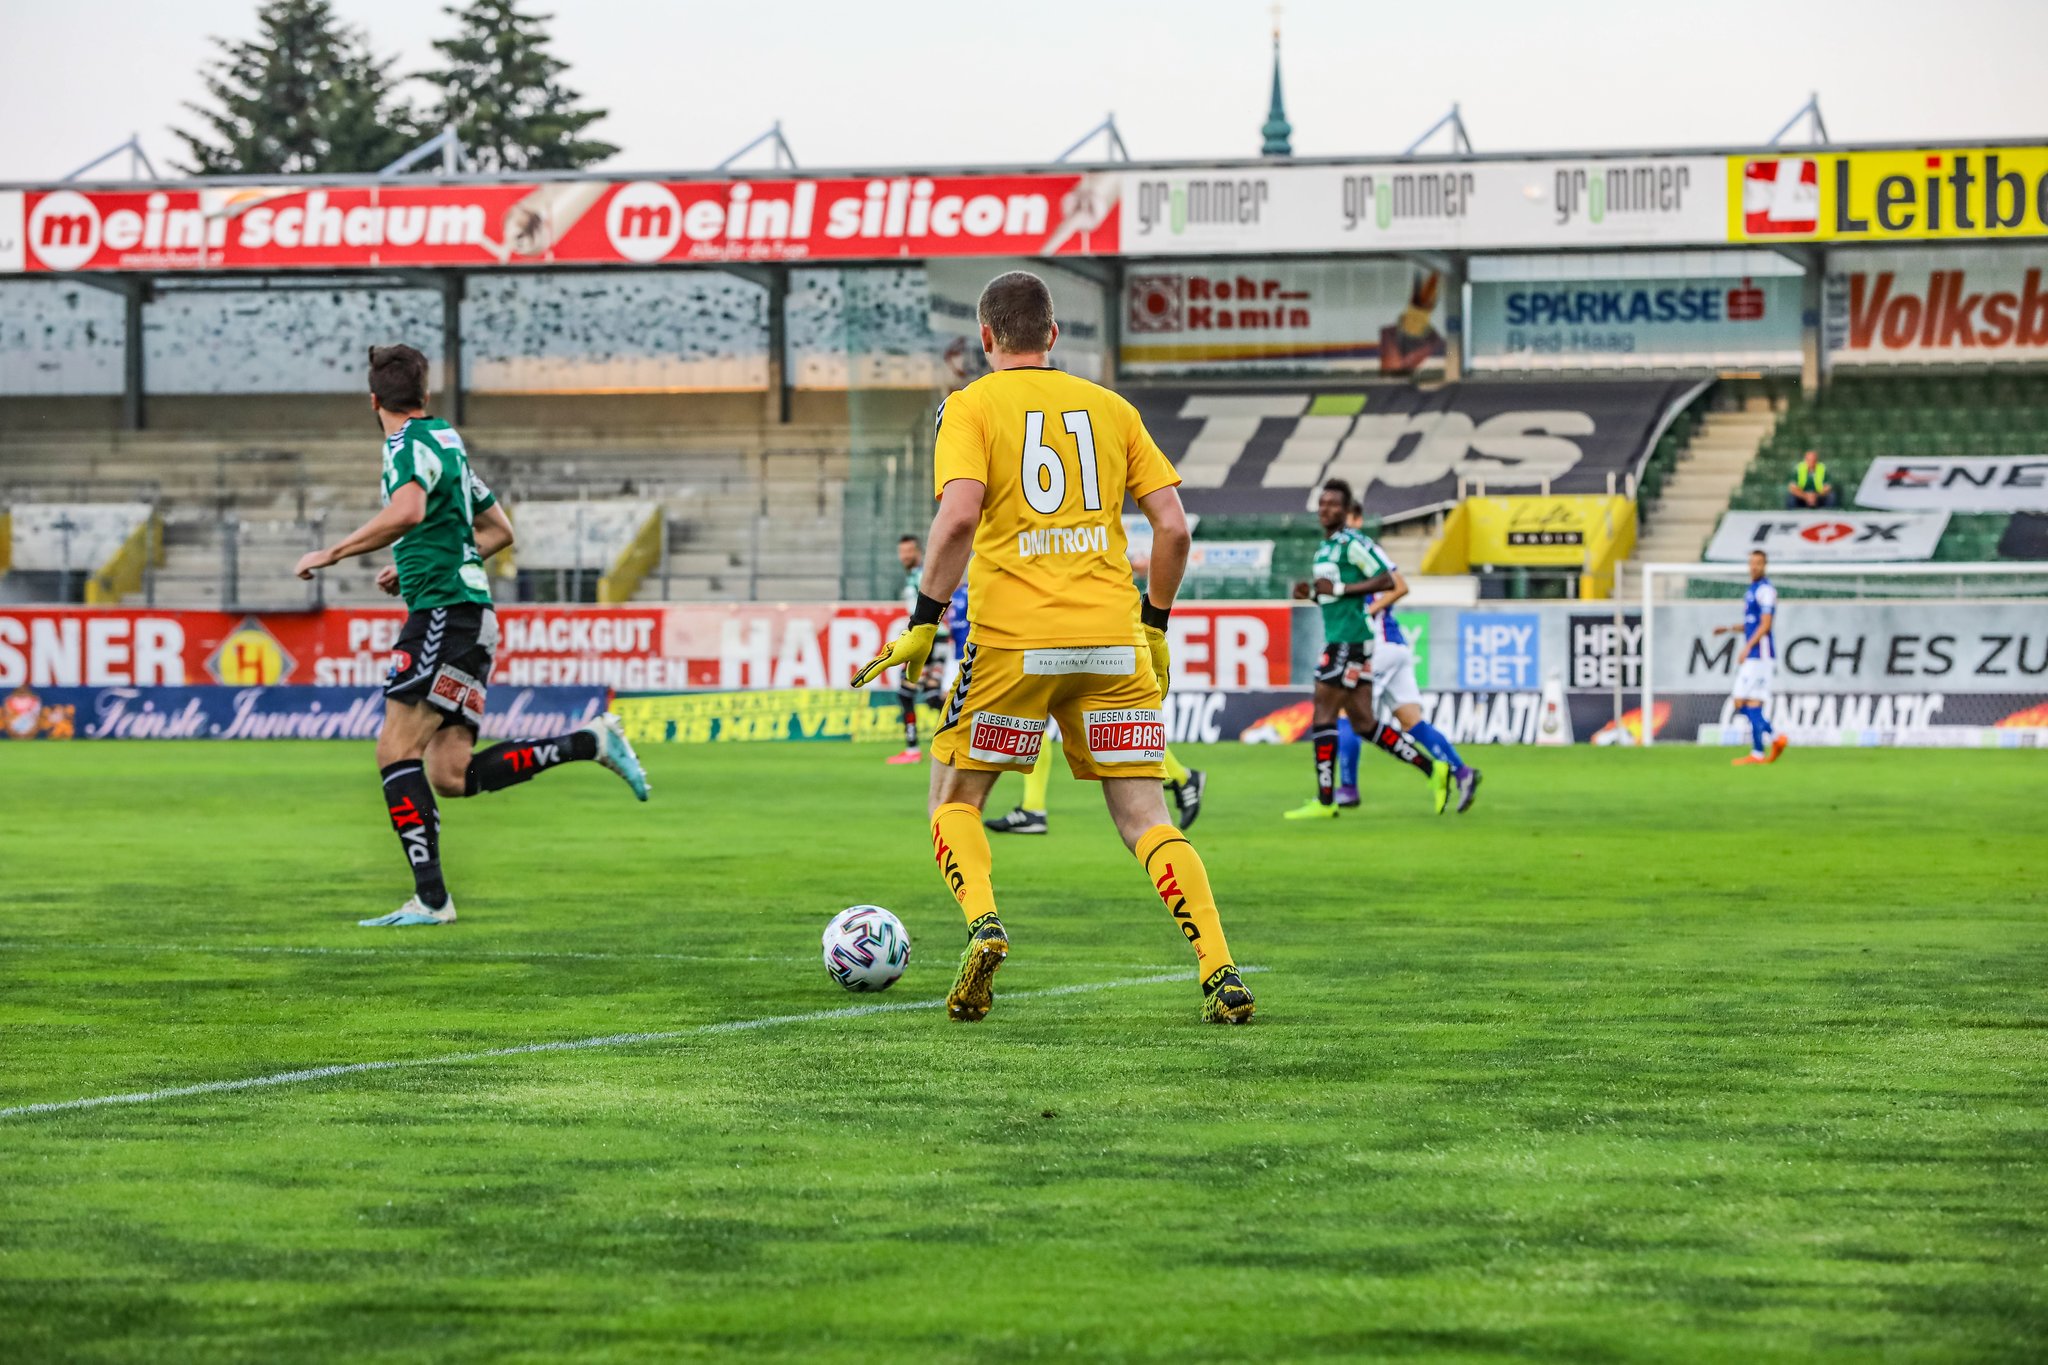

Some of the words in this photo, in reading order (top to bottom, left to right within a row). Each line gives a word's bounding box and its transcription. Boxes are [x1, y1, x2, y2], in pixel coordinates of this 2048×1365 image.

[239, 189, 486, 249] schaum
[609, 183, 818, 255] meinl
[825, 179, 1048, 239] silicon
[1188, 305, 1311, 330] Kamin
[1506, 288, 1721, 325] SPARKASSE
[1020, 410, 1102, 514] 61
[1174, 393, 1596, 513] Tips
[1018, 526, 1108, 557] DMITROVI
[1464, 626, 1533, 655] HPY
[1574, 624, 1642, 655] HPY
[1464, 656, 1532, 686] BET
[1688, 635, 1866, 676] MCH
[1886, 635, 1955, 676] ES
[1574, 656, 1642, 687] BET
[978, 712, 1012, 728] FLIESEN
[1089, 711, 1123, 723] FLIESEN
[1126, 711, 1132, 721] &
[1134, 710, 1156, 721] STEIN
